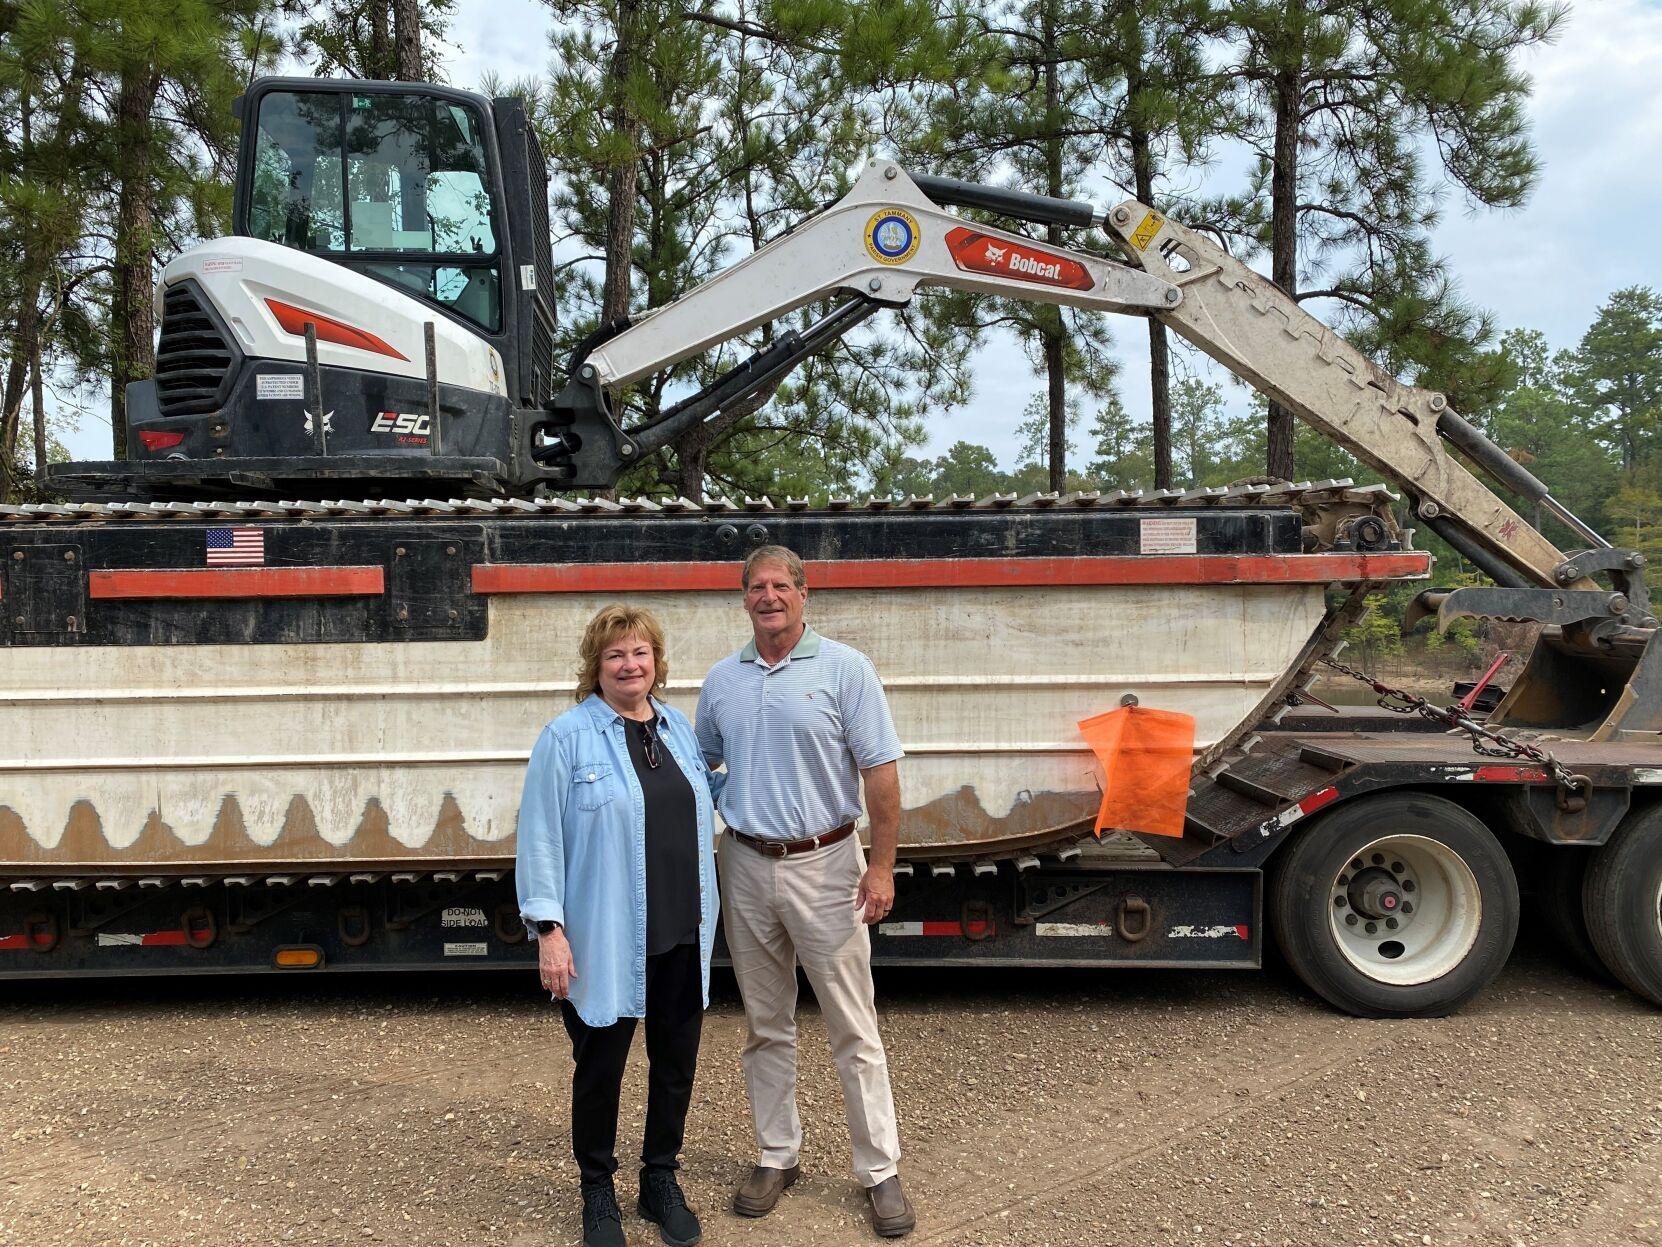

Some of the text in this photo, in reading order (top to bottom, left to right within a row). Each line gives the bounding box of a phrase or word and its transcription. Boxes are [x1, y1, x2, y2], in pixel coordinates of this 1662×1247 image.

[884, 211, 913, 224] TAMMANY
[869, 243, 916, 263] PARISH GOVERNMENT
[1009, 253, 1061, 279] Bobcat
[441, 919, 462, 928] SIDE
